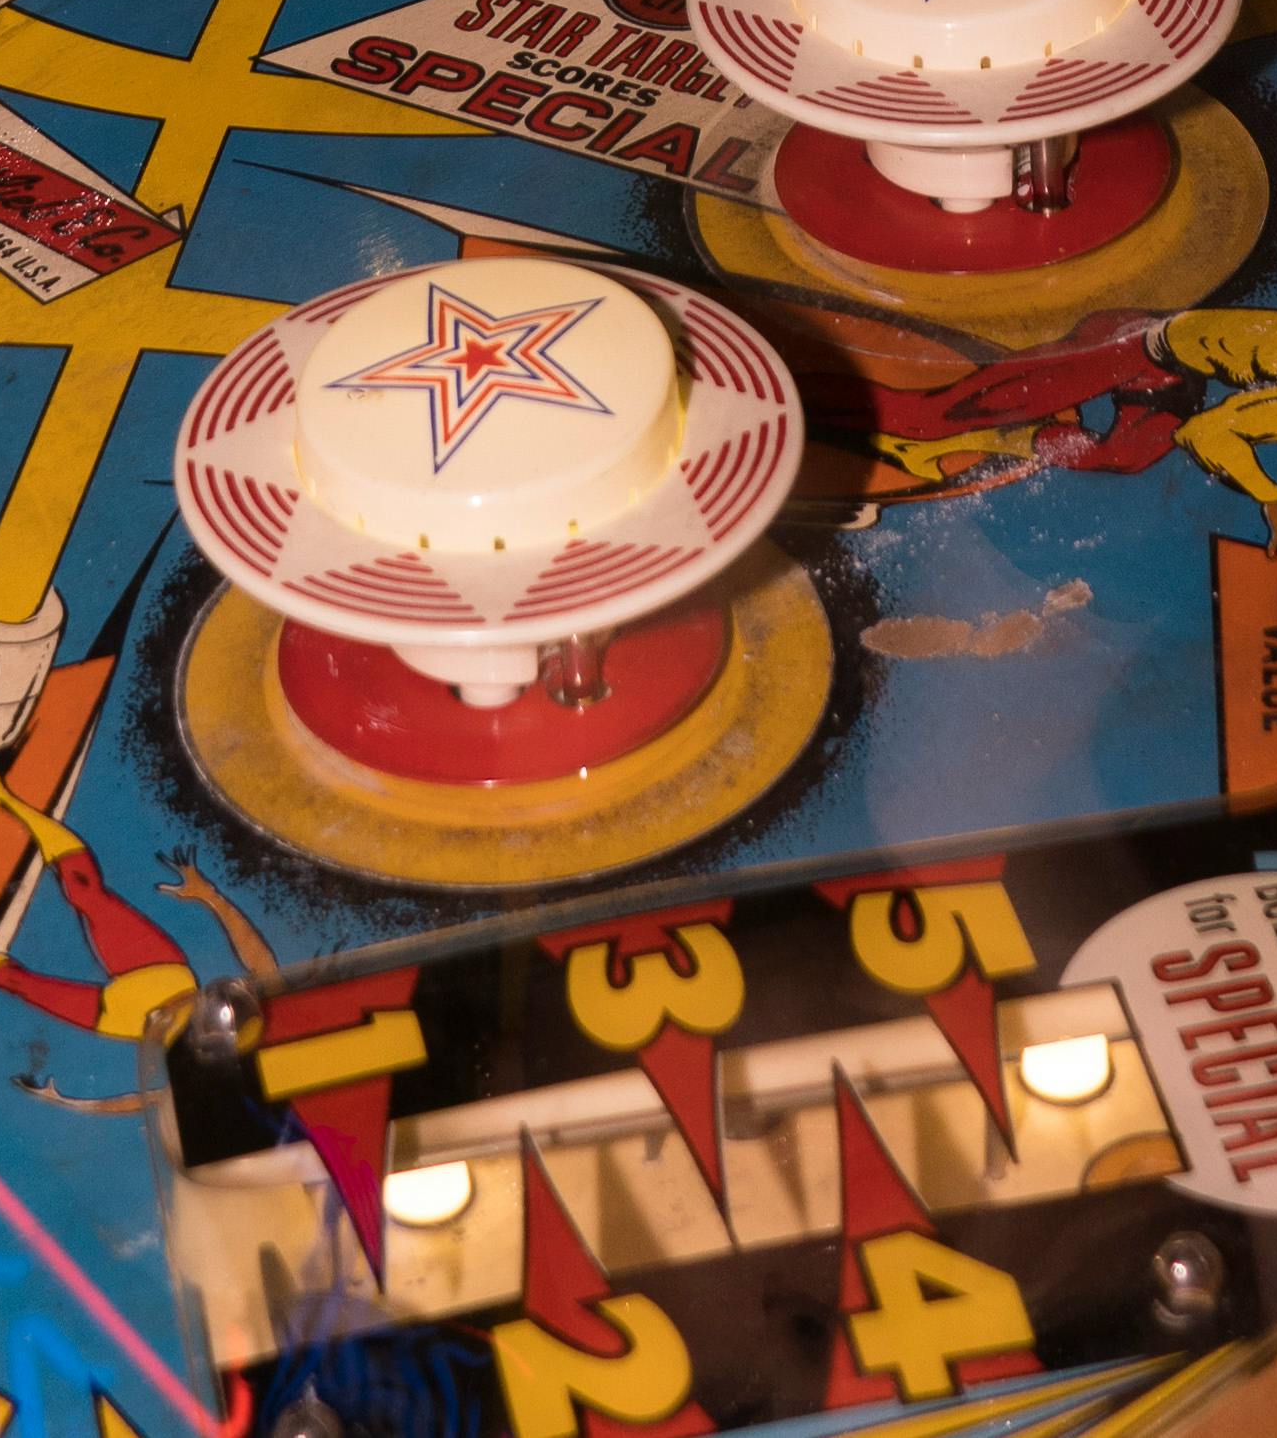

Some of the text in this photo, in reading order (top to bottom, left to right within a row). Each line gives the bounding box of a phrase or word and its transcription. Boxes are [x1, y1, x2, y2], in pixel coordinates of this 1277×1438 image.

[330, 36, 758, 191] SPECIAL
[506, 51, 662, 108] SCORES
[585, 22, 754, 109] TARGE
[12, 255, 62, 294] U.S.A.
[846, 879, 1038, 998] 5
[1183, 891, 1239, 934] for
[563, 919, 747, 1053] 3
[252, 1008, 430, 1102] 1
[490, 1291, 695, 1438] 2
[848, 1229, 1038, 1397] 4
